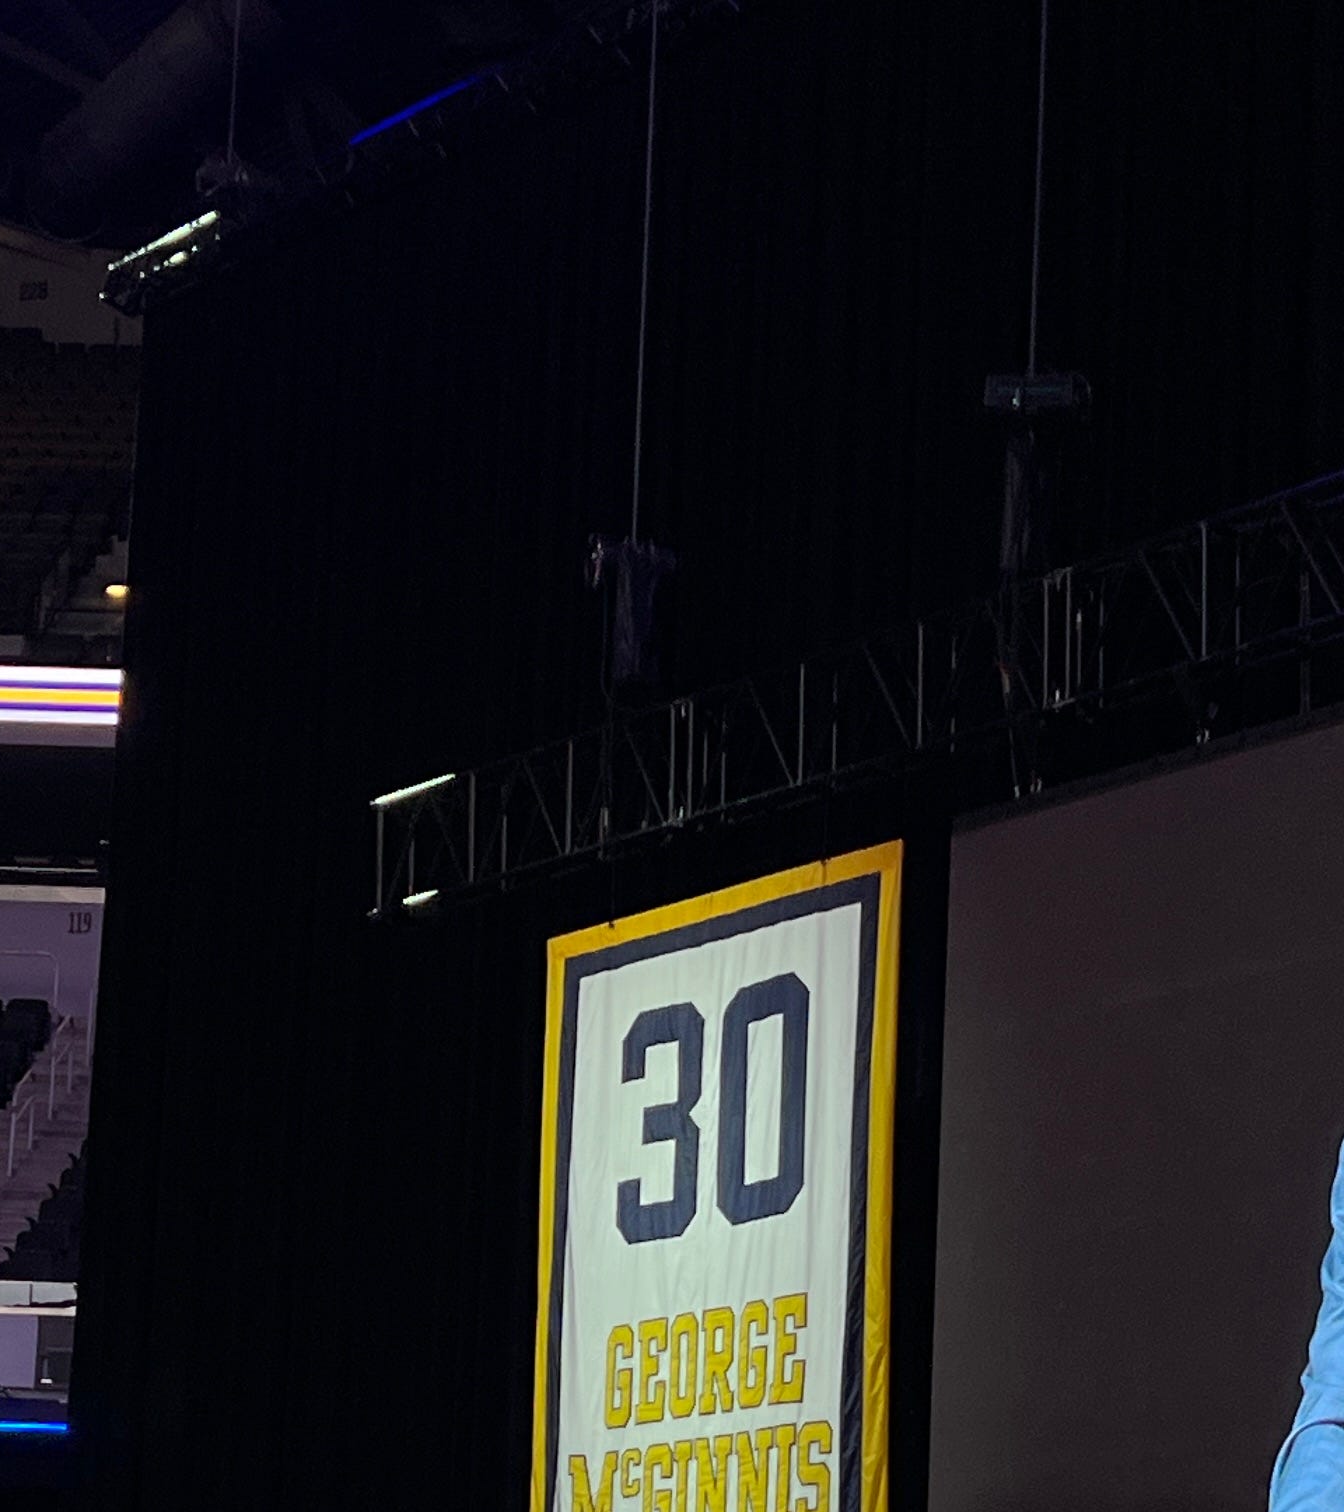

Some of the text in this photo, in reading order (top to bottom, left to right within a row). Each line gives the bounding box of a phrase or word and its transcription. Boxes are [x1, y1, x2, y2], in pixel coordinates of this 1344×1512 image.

[68, 911, 92, 934] 119
[616, 972, 810, 1245] 30
[604, 1292, 808, 1429] GEORGE
